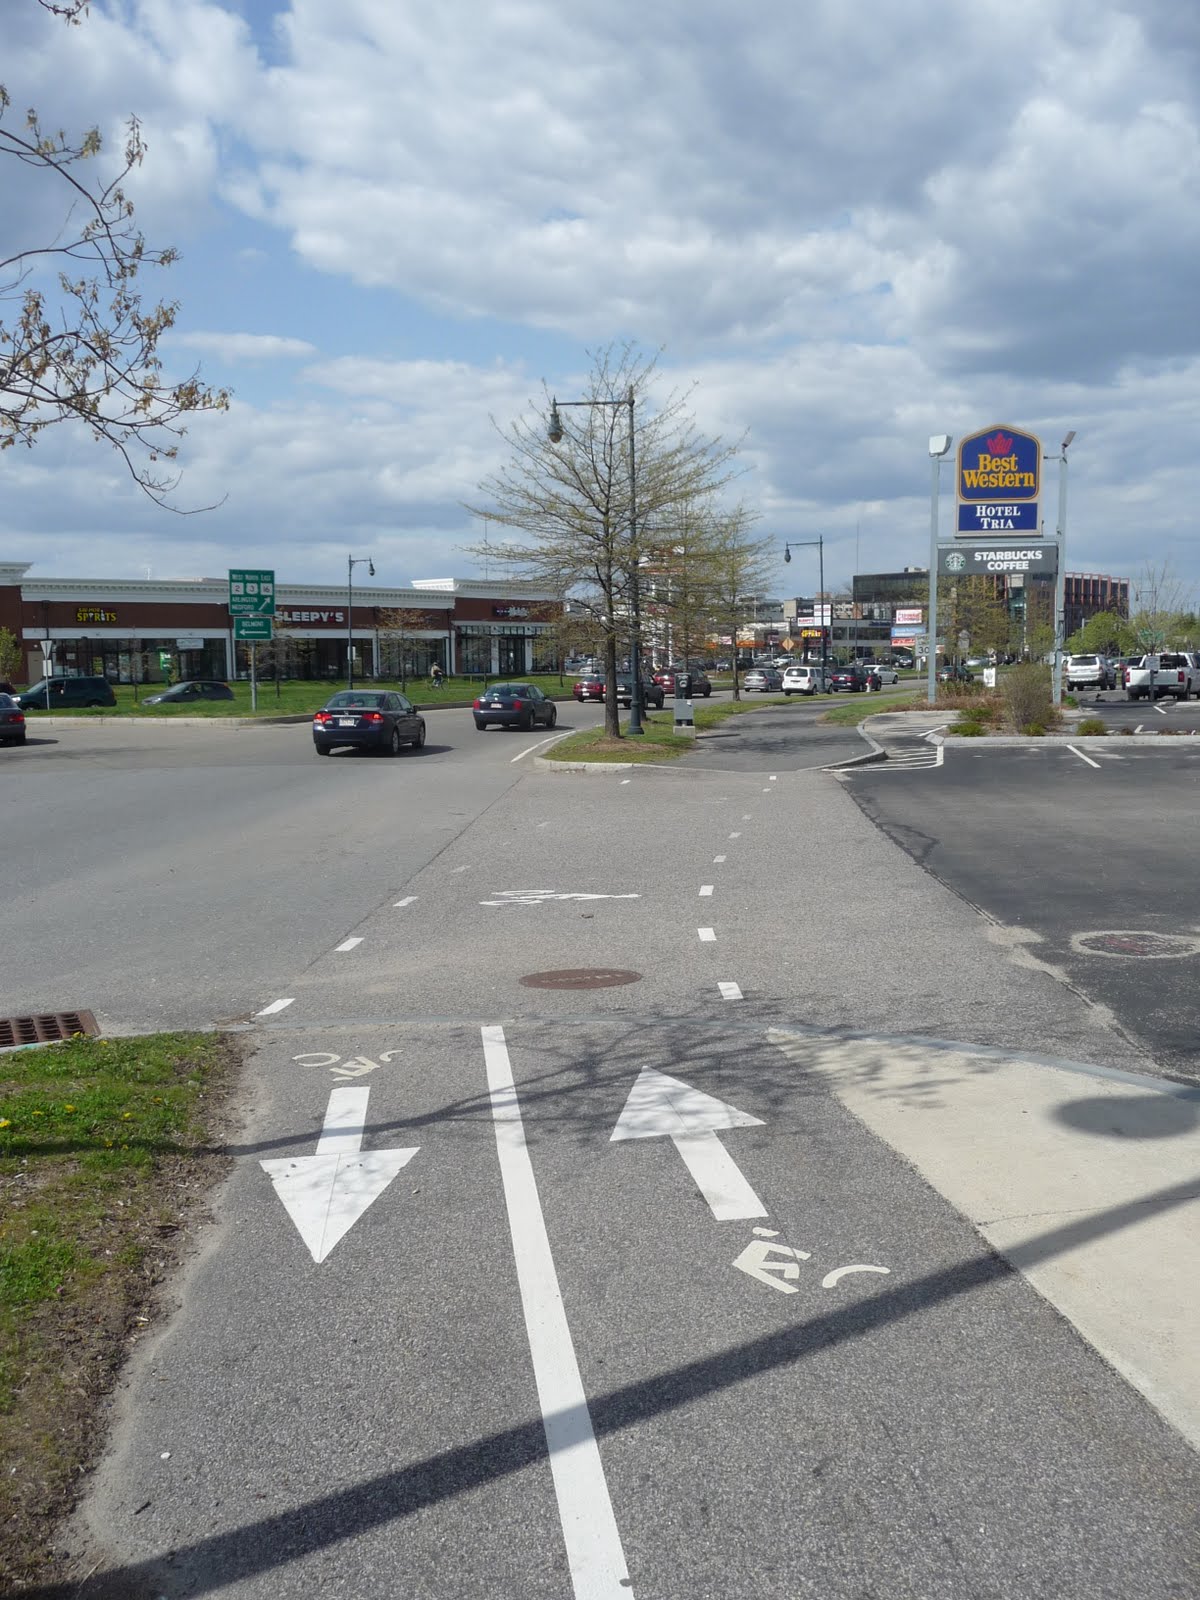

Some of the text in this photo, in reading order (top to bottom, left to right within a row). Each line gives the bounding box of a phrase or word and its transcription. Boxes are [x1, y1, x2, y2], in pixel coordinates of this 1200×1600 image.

[977, 453, 1018, 472] Best
[962, 469, 1035, 488] Western
[976, 505, 1021, 517] HOTEL
[980, 518, 1015, 529] TRIA
[974, 550, 1043, 561] STARBUCKS
[987, 560, 1030, 571] COFFEE
[274, 610, 345, 623] SLEEPY'S
[918, 646, 930, 654] 30
